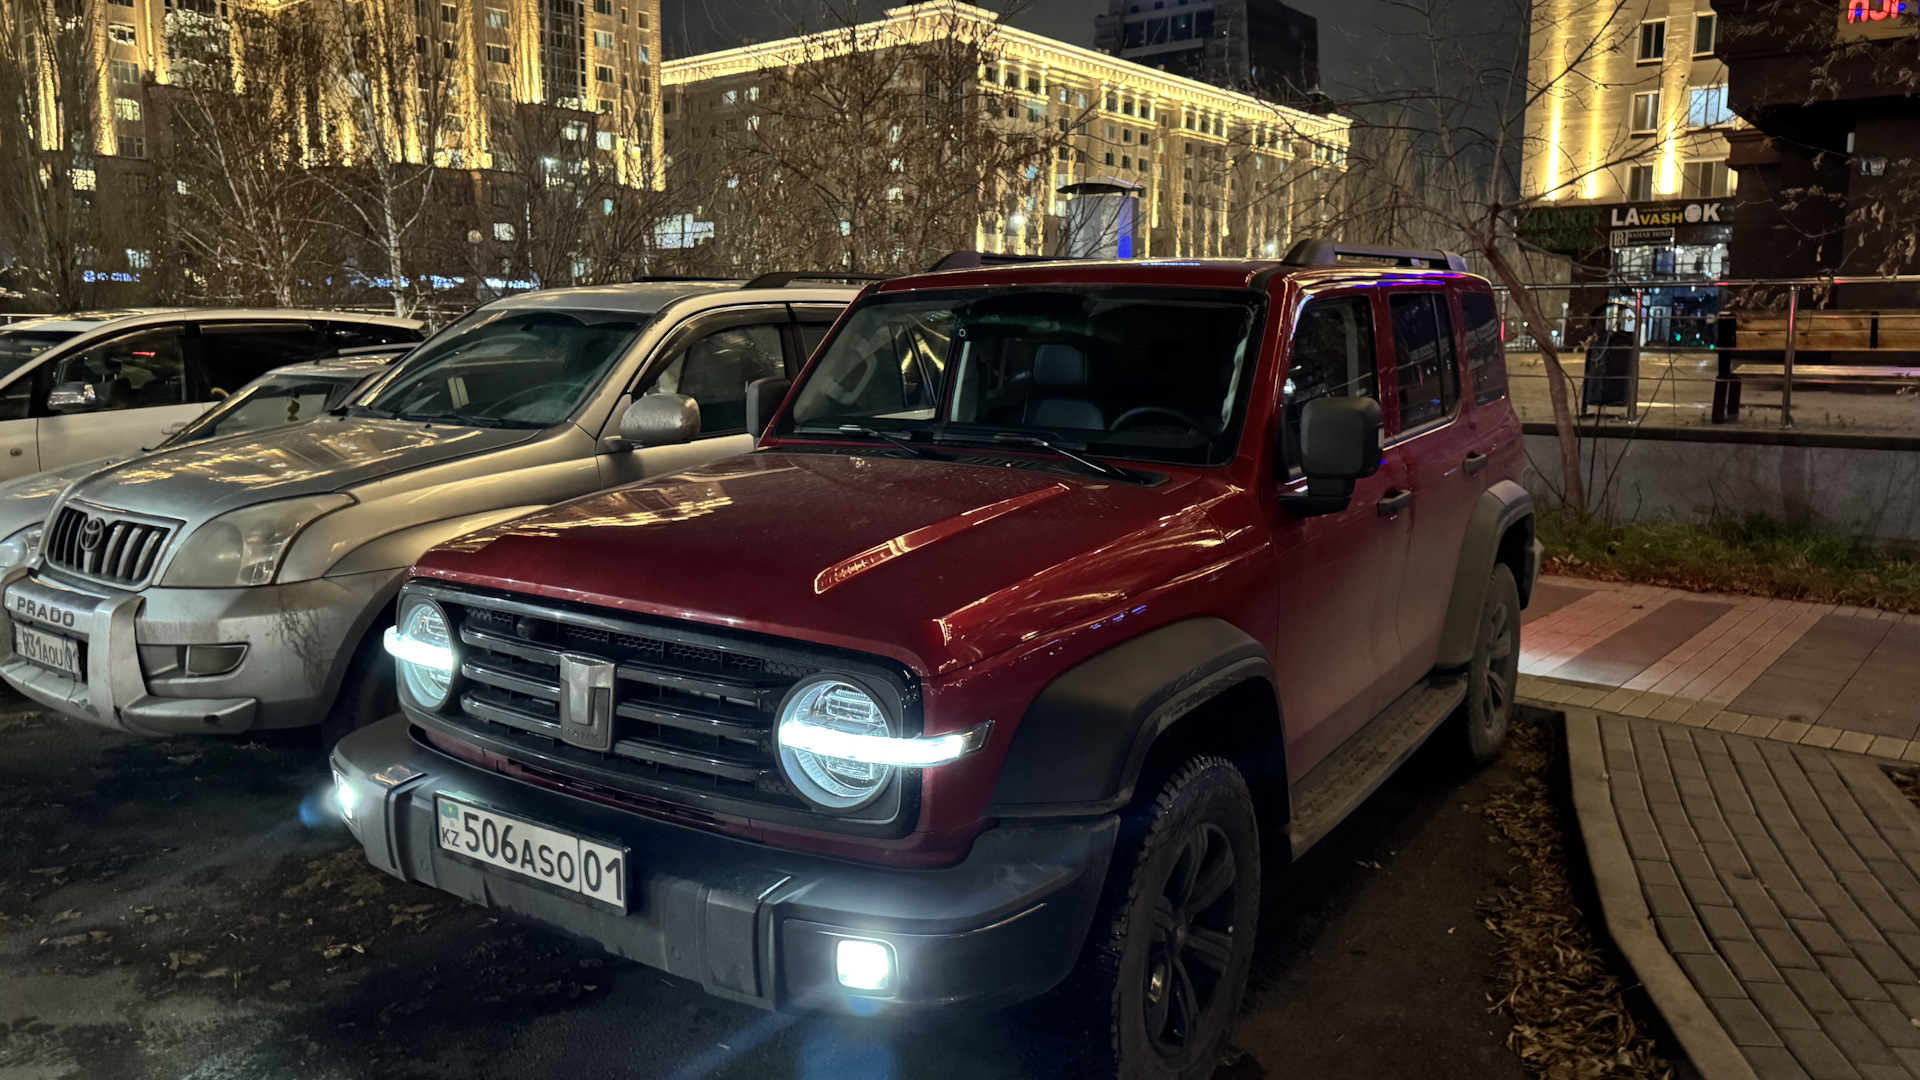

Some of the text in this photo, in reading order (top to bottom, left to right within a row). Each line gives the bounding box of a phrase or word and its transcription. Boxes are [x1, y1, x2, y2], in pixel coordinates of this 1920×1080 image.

[17, 596, 75, 628] PRADO
[565, 726, 600, 742] TANK
[441, 826, 460, 848] KZ
[583, 849, 623, 901] 01
